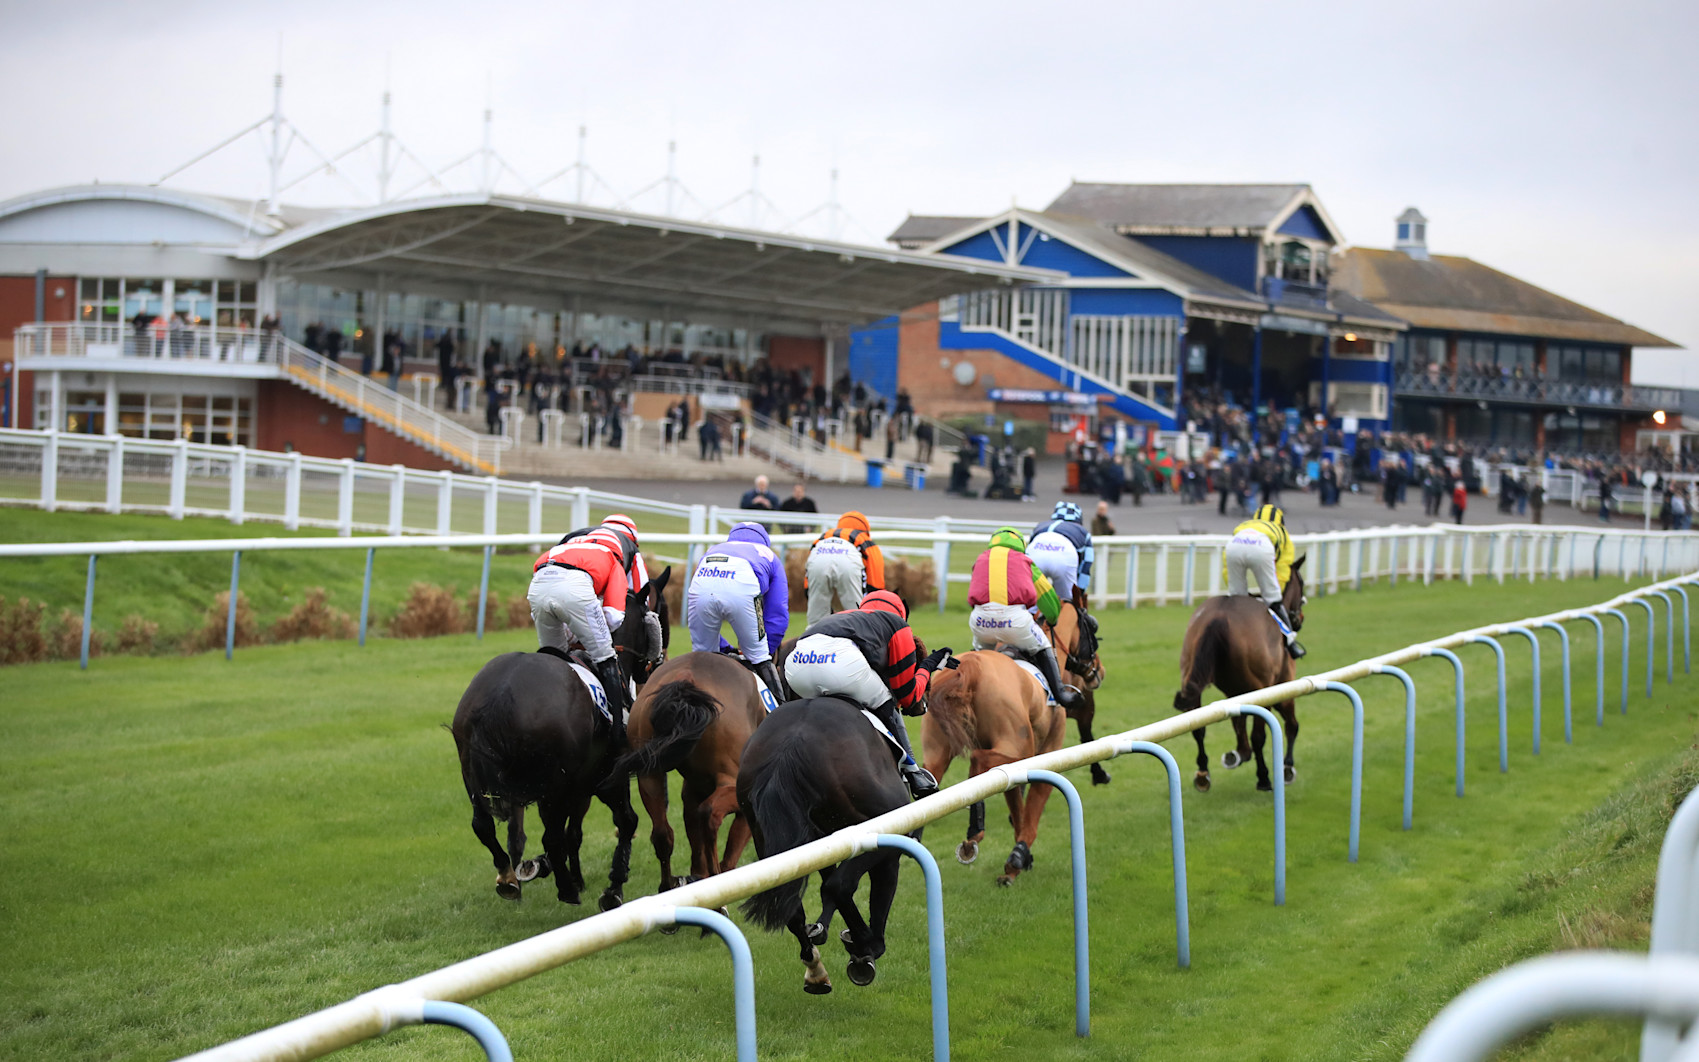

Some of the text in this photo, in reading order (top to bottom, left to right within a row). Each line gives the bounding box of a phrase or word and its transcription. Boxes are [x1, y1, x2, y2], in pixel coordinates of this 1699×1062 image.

[816, 546, 849, 555] Stobart
[1033, 542, 1065, 552] Stobart
[697, 566, 736, 580] Stobart
[976, 616, 1012, 628] Stobart
[793, 650, 836, 664] Stobart
